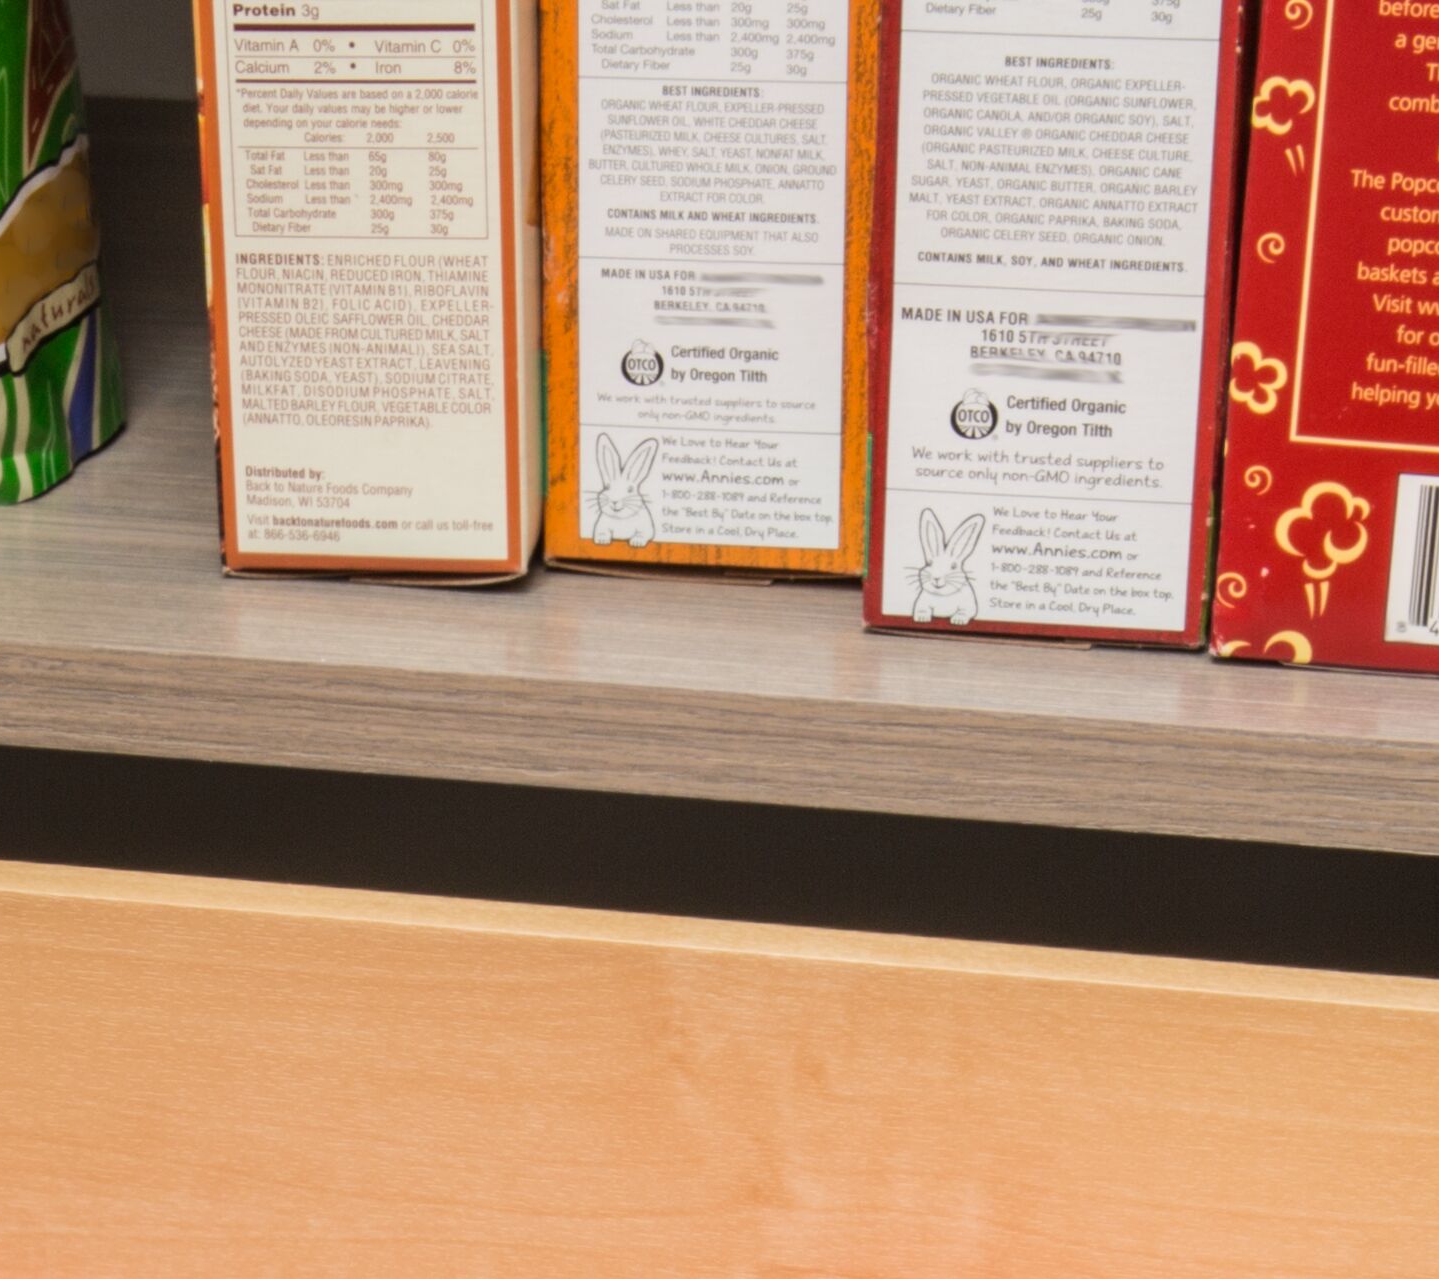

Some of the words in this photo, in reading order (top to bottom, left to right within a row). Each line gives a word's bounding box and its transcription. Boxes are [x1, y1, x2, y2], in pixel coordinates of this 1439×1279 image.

[232, 3, 295, 16] Protein
[301, 5, 319, 19] 3g
[234, 60, 289, 73] Calcium
[314, 60, 336, 74] 2%
[375, 60, 401, 74] Iron
[453, 60, 476, 74] 8%
[1350, 169, 1385, 189] The
[917, 251, 971, 263] CONTAINS
[1041, 256, 1063, 267] AND
[1067, 258, 1104, 268] WHEAT
[1372, 293, 1412, 314] Visit
[901, 306, 940, 321] MADE
[947, 309, 960, 321] IN
[966, 310, 994, 323] USA
[999, 311, 1027, 325] FOR
[670, 345, 725, 359] Certified
[728, 347, 778, 362] Organic
[628, 359, 656, 370] OTCO
[670, 368, 685, 382] by
[689, 368, 735, 383] Oregon
[740, 369, 767, 381] Tilth
[1351, 381, 1420, 408] helping
[1006, 395, 1066, 411] Certified
[1071, 398, 1125, 415] Organic
[958, 410, 990, 424] OTCO
[1005, 420, 1021, 436] by
[1026, 420, 1077, 437] Oregon
[1082, 423, 1112, 437] Tilth
[245, 466, 305, 479] Distributed
[662, 470, 784, 485] www.Annies.com
[247, 515, 270, 524] Visit
[992, 543, 1122, 560] www.Annies.com
